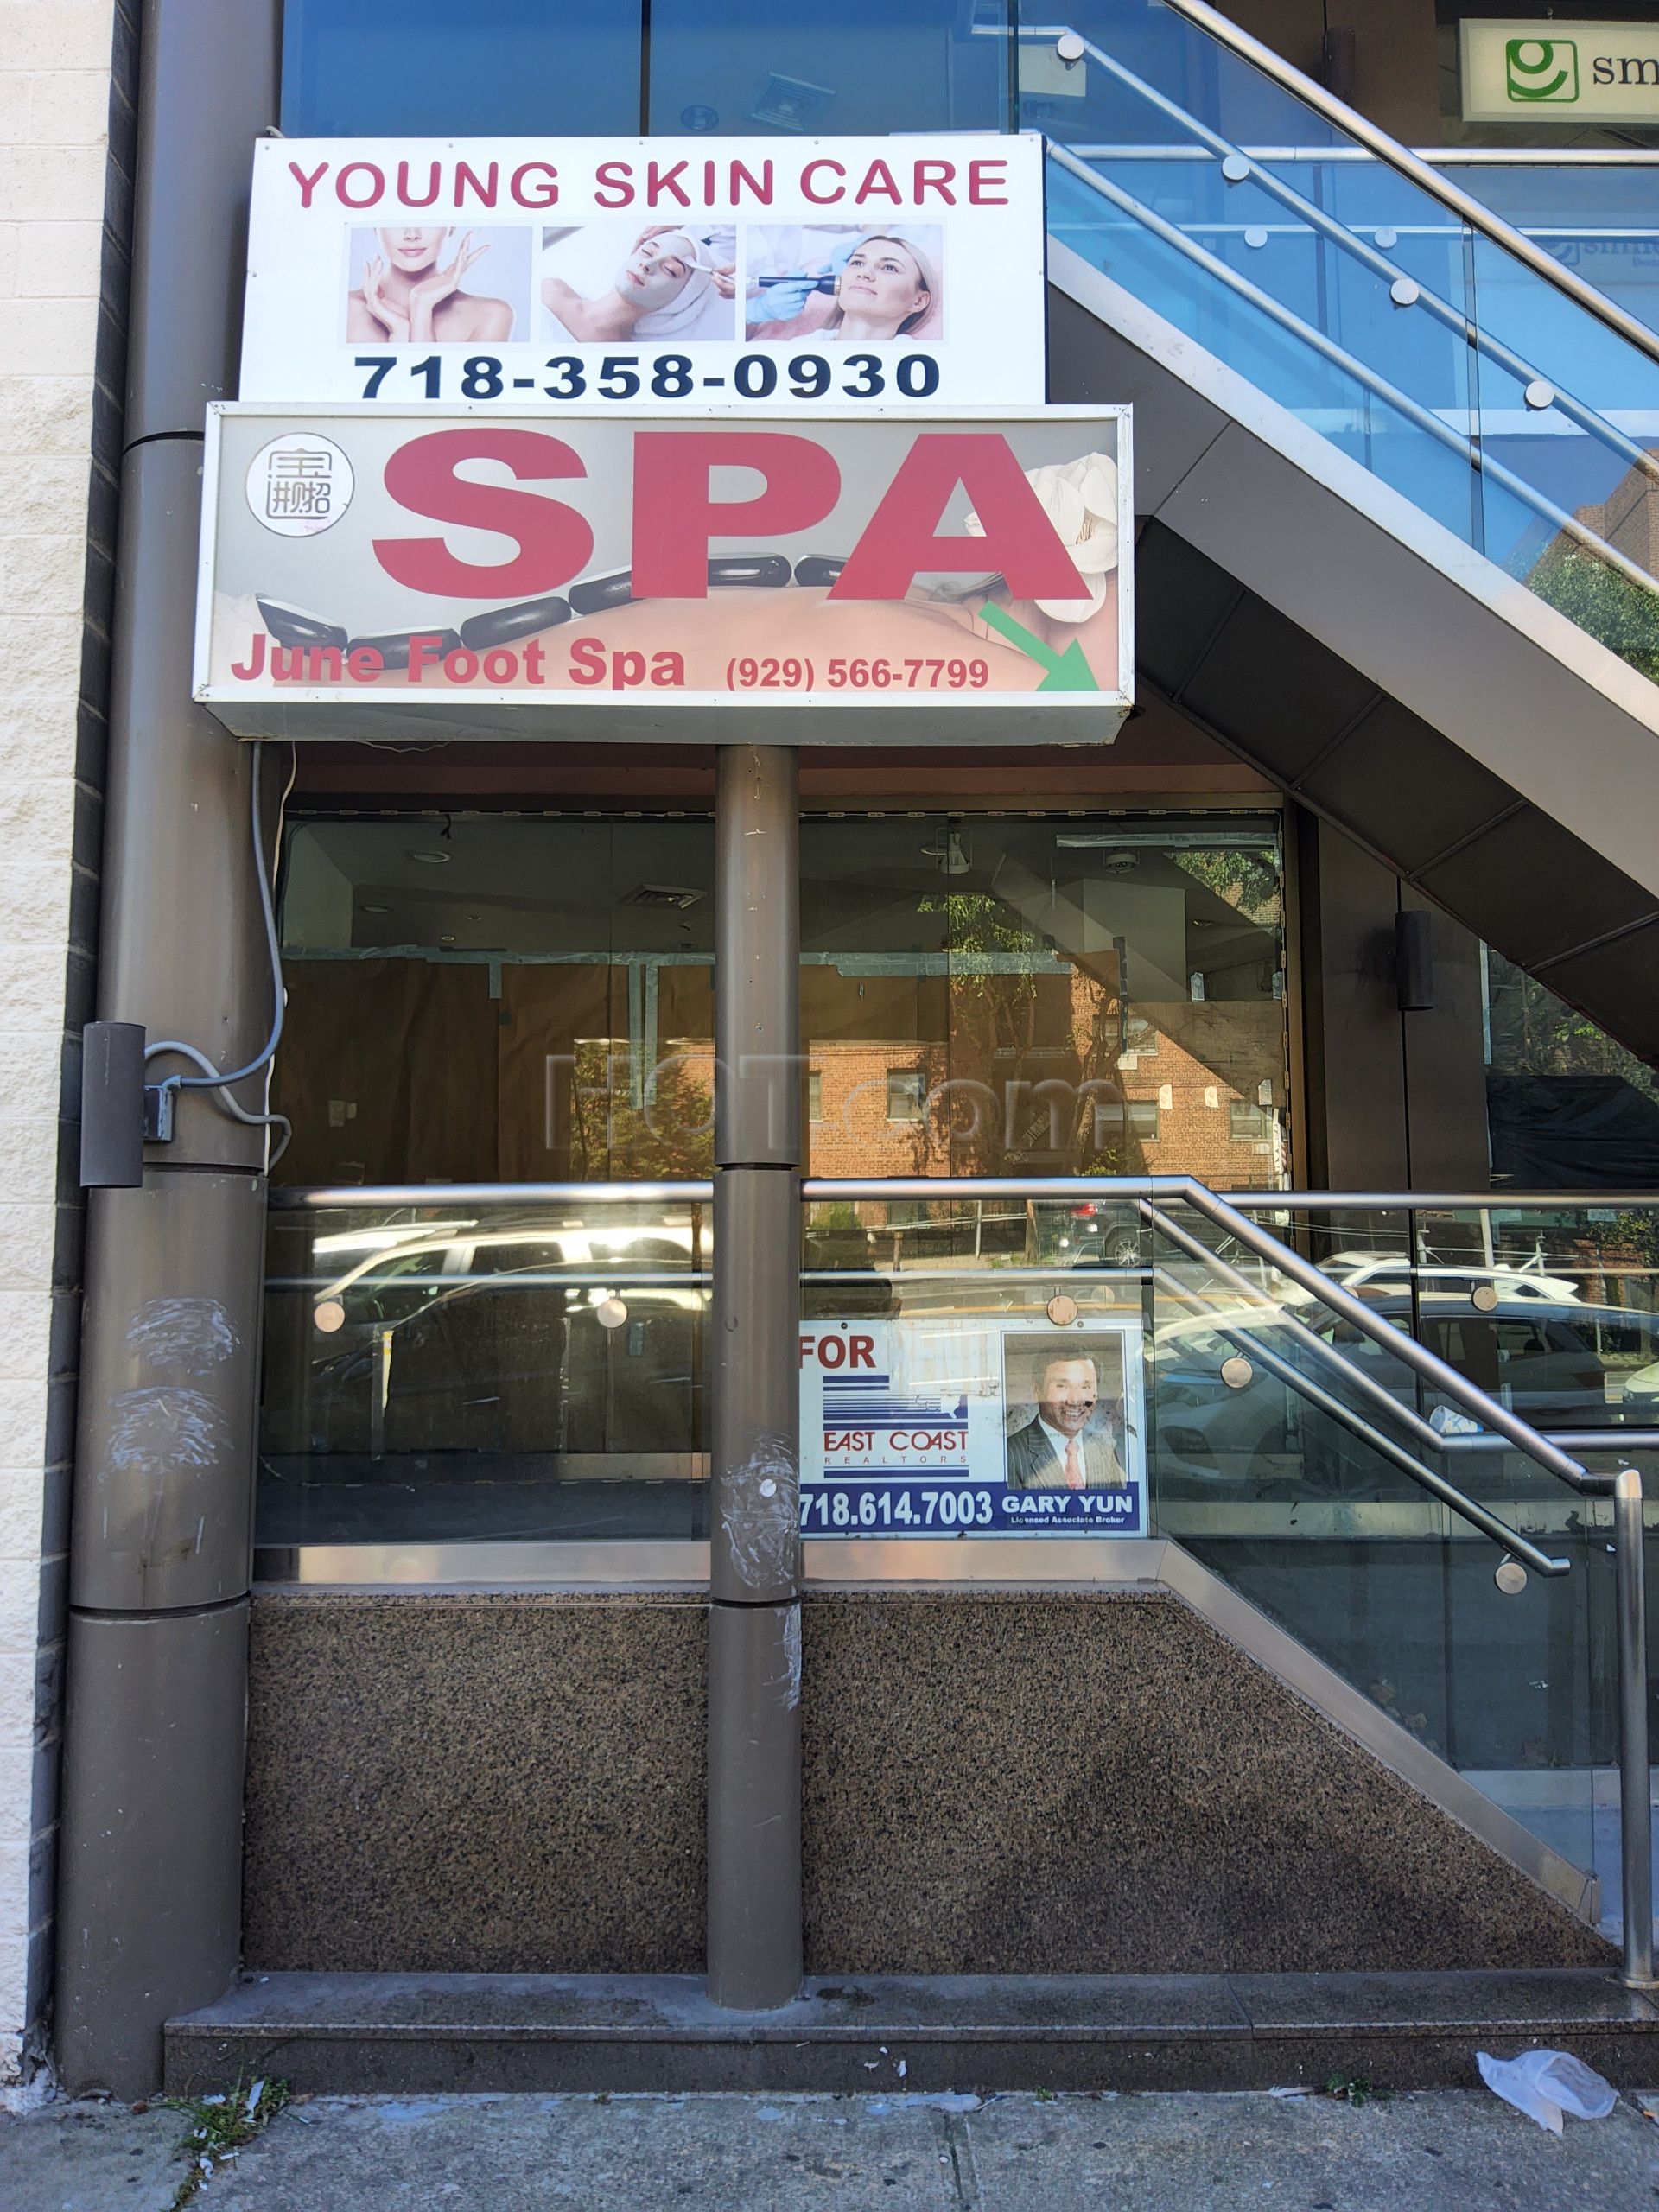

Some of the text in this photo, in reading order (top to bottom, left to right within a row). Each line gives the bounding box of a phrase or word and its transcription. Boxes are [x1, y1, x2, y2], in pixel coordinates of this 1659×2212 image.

[289, 160, 1009, 209] YOUNG SKIN CARE
[353, 353, 940, 400] 718-358-0930
[372, 428, 1093, 600] SPA
[232, 634, 685, 691] June Foot Spa
[725, 658, 989, 692] (929) 566-7799
[799, 1335, 876, 1369] FOR
[824, 1431, 969, 1452] EAST COAST
[1001, 1495, 1133, 1513] GARY YUN
